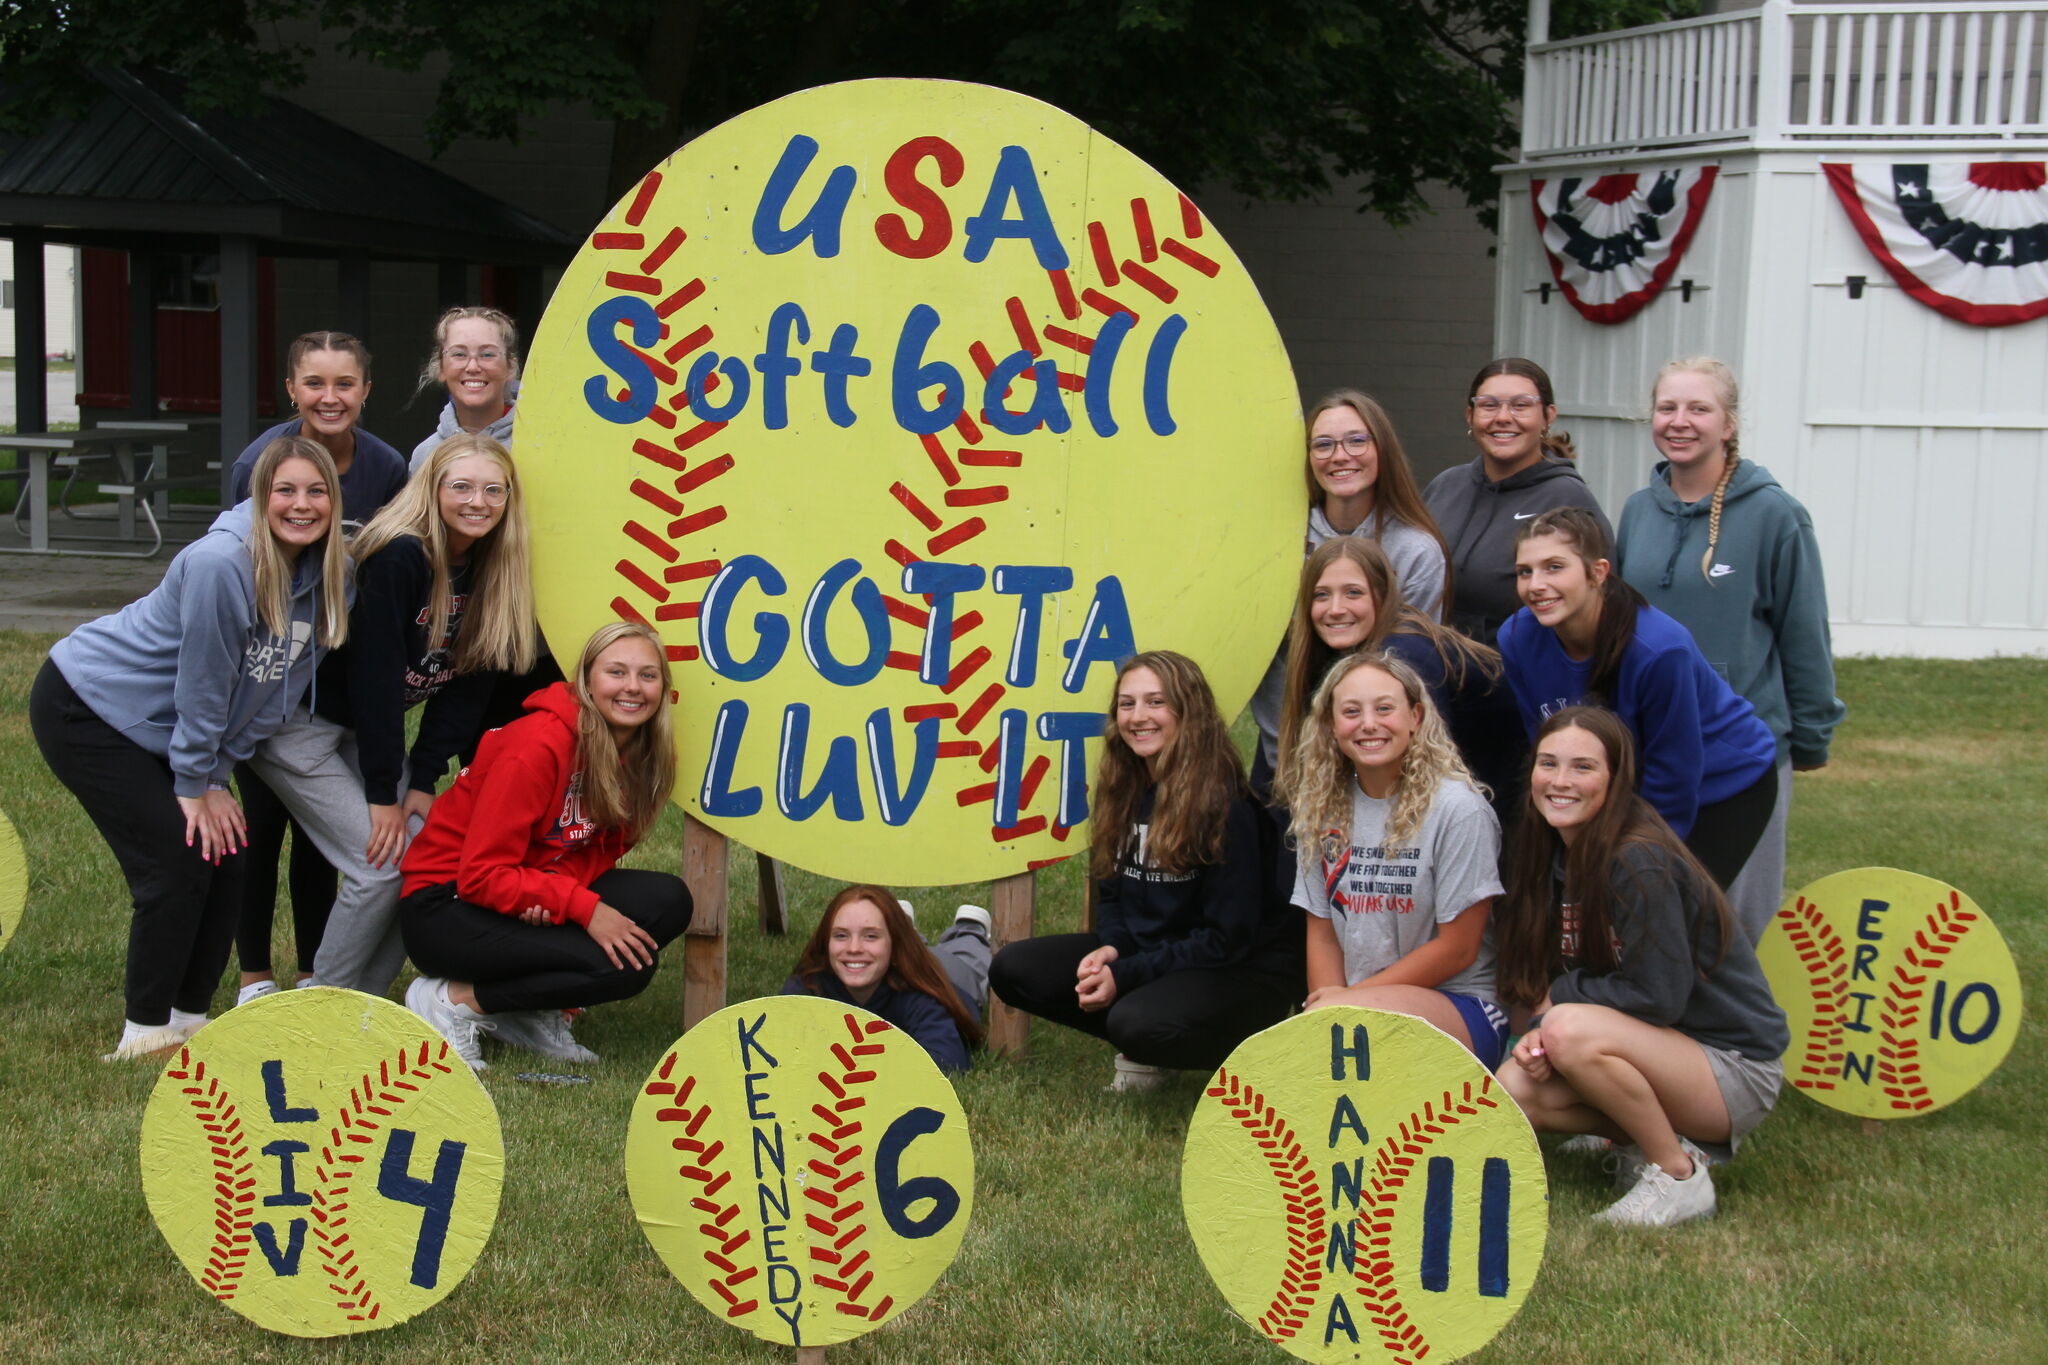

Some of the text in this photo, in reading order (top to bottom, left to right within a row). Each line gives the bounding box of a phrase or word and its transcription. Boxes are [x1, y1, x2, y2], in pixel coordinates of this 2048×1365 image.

[752, 134, 1069, 270] USA
[584, 295, 1187, 437] Softball
[698, 554, 1137, 693] GOTTA
[700, 699, 941, 825] LUV
[993, 708, 1109, 829] IT
[1349, 862, 1363, 876] WE
[1350, 880, 1363, 893] WE
[1351, 846, 1365, 859] WE
[1386, 895, 1415, 914] USA
[1842, 899, 1890, 1085] ERIN
[1930, 980, 2001, 1044] 10
[251, 1059, 319, 1276] LIV
[376, 1128, 467, 1290] 4
[738, 1013, 802, 1347] KENNEDY
[875, 1107, 960, 1239] 6
[1325, 1022, 1370, 1345] HANNA
[1420, 1156, 1510, 1298] 11
